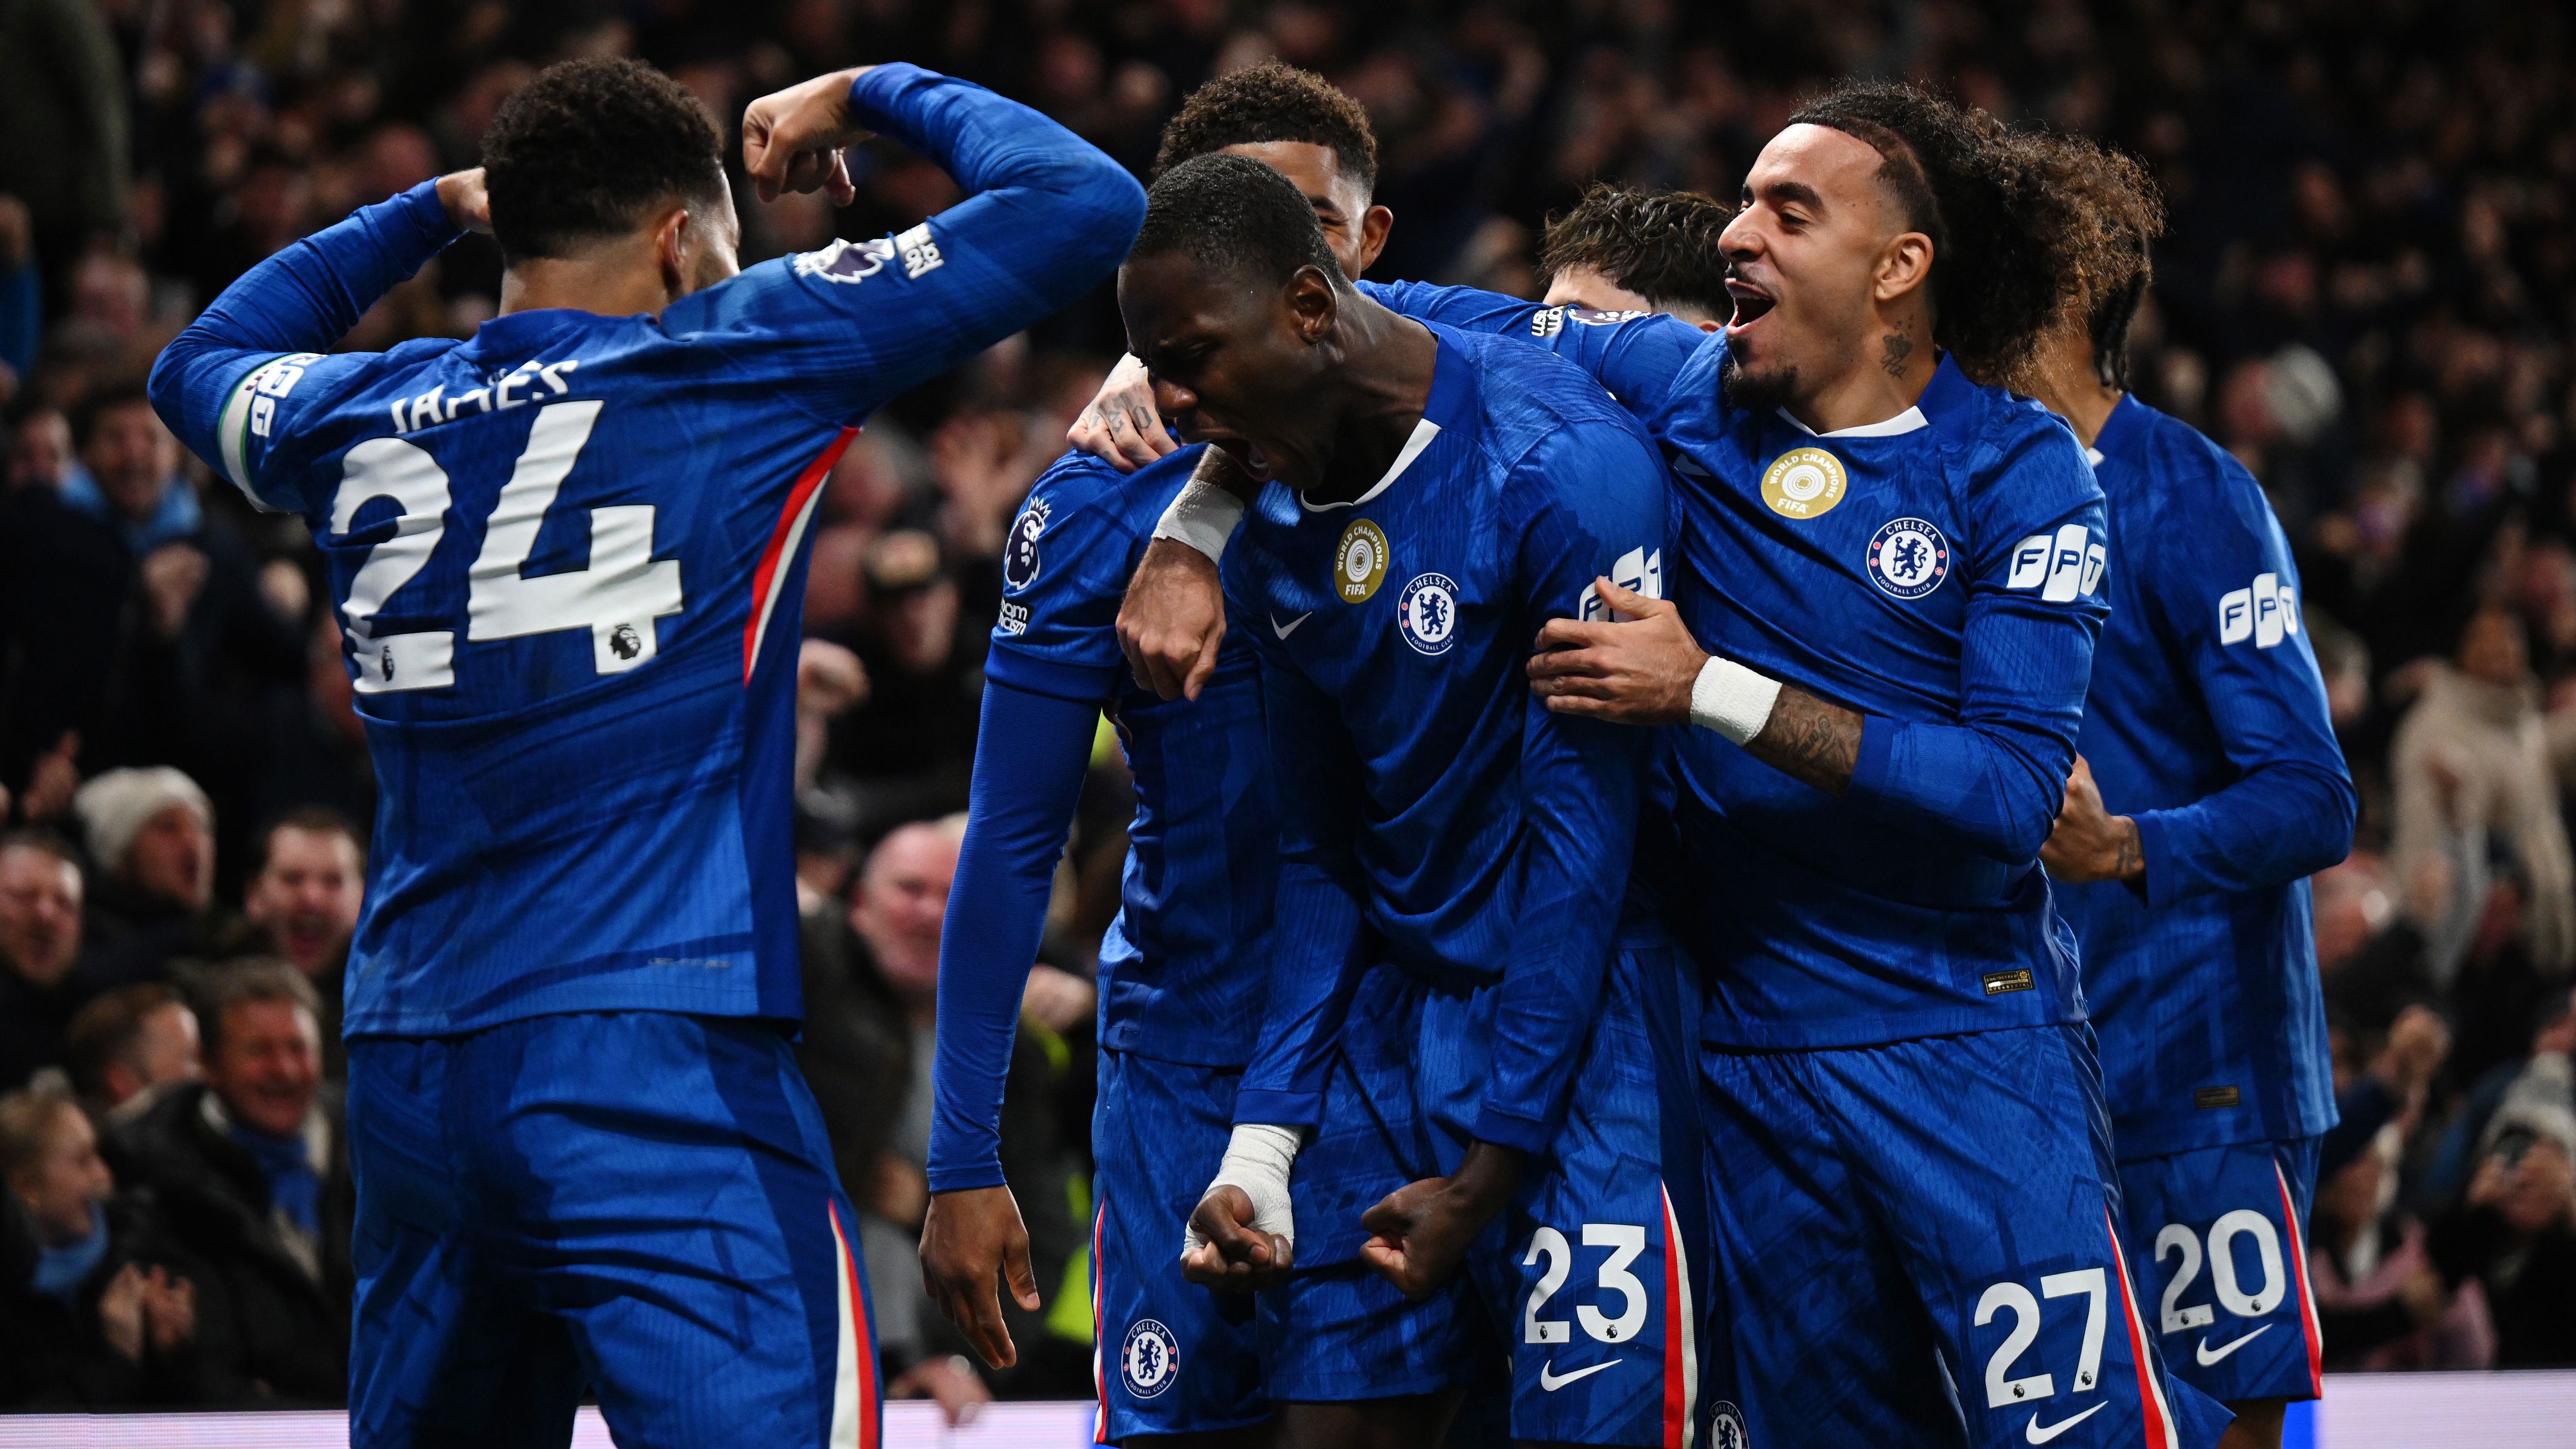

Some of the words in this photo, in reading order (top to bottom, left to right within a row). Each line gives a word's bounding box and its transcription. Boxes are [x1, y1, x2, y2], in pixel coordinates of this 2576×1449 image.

[1769, 456, 1799, 484] WORLD
[1802, 453, 1839, 498] CHAMPIONS
[1777, 497, 1807, 514] FIFA
[1885, 521, 1937, 542] CHELSEA
[329, 400, 683, 694] 24
[1338, 533, 1353, 571] WORLD
[1354, 526, 1383, 570] CHAMPIONS
[1345, 584, 1366, 596] FIFA
[1409, 576, 1451, 593] CHELSEA
[1878, 575, 1910, 595] FOOTBALL
[1913, 582, 1931, 593] CLUB
[1411, 636, 1439, 650] FOOTBALL
[1441, 634, 1453, 648] CLUB
[2155, 1209, 2286, 1334] 20
[1522, 1223, 1648, 1344] 23
[1132, 1322, 1165, 1339] CHELSEA
[1974, 1267, 2107, 1408] 27
[1128, 1380, 1151, 1394] FOOTBALL
[1153, 1380, 1167, 1391] CLUB
[1711, 1403, 1739, 1421] CHELSEA
